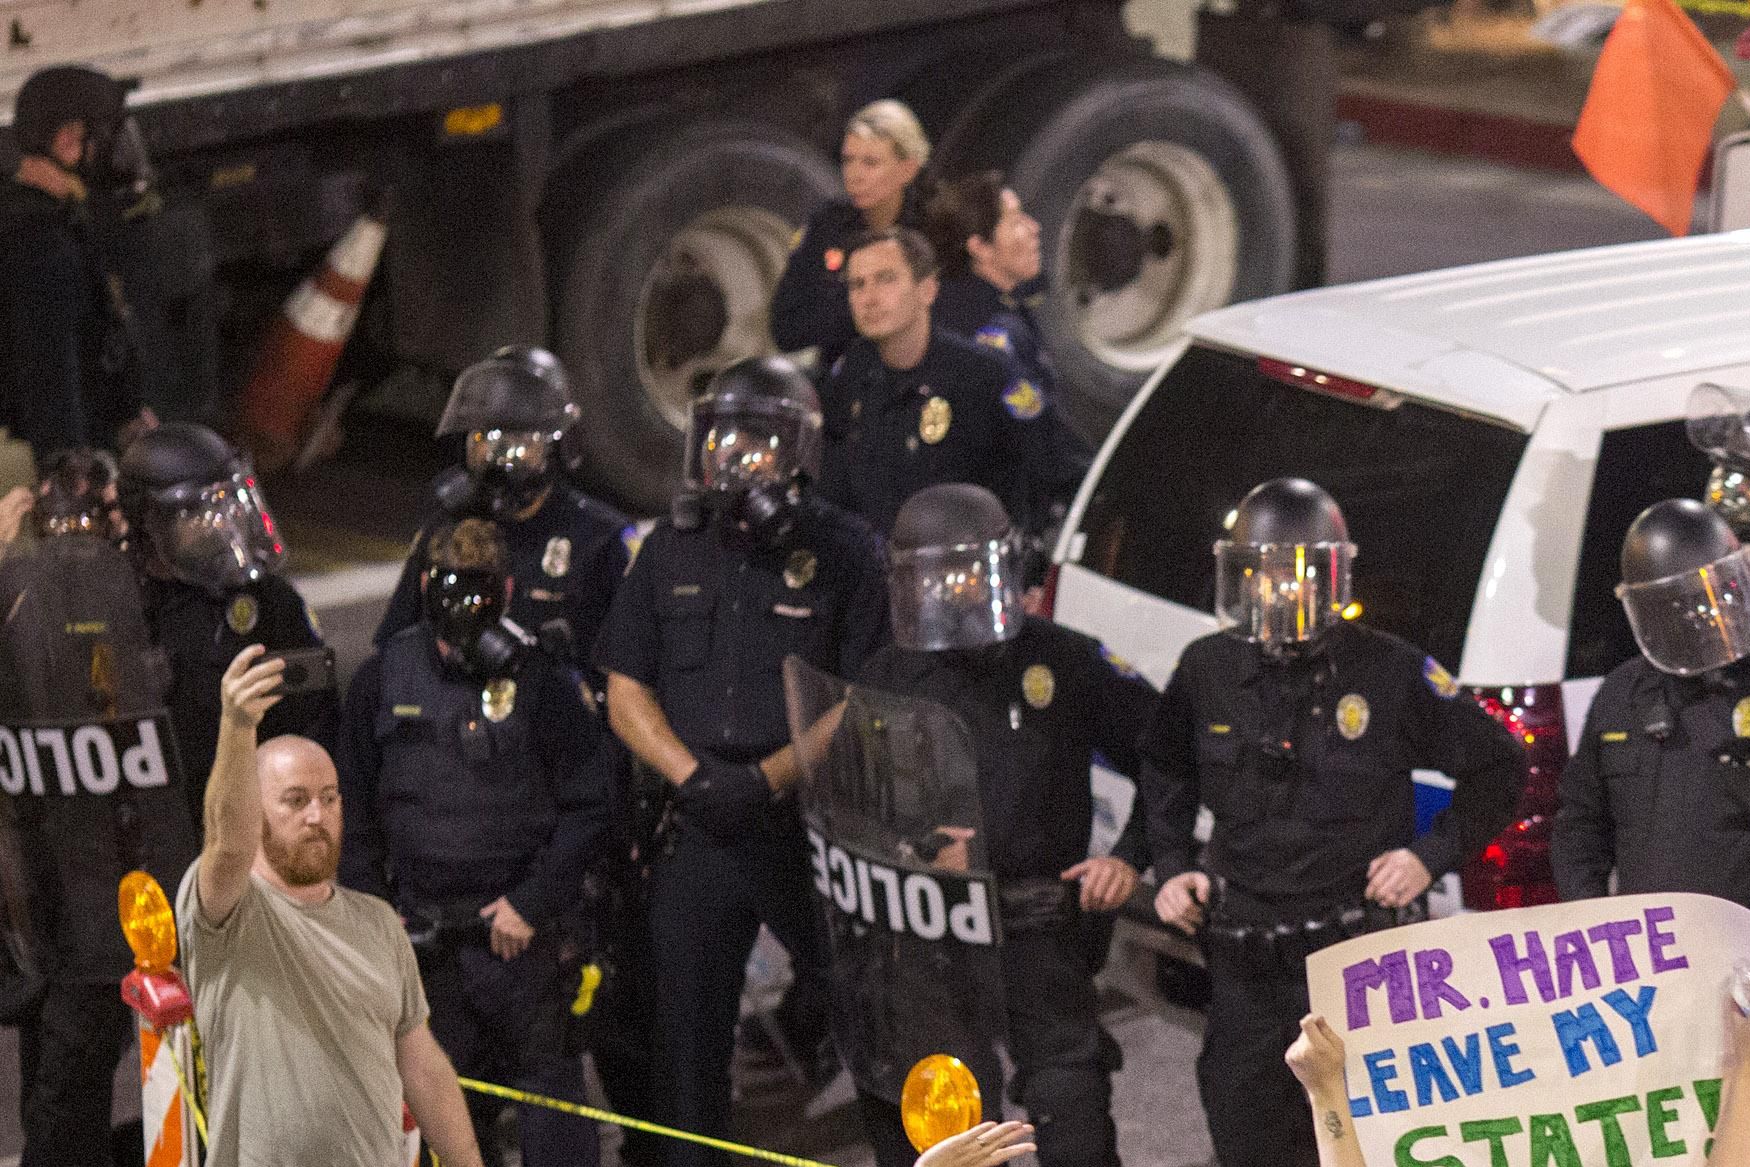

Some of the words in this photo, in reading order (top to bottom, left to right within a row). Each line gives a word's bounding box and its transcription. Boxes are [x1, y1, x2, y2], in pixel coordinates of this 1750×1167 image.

[0, 718, 169, 796] POLIC
[808, 828, 992, 946] POLICE
[1342, 949, 1490, 1031] MR.
[1489, 905, 1689, 1006] HATE
[1551, 985, 1658, 1077] MY
